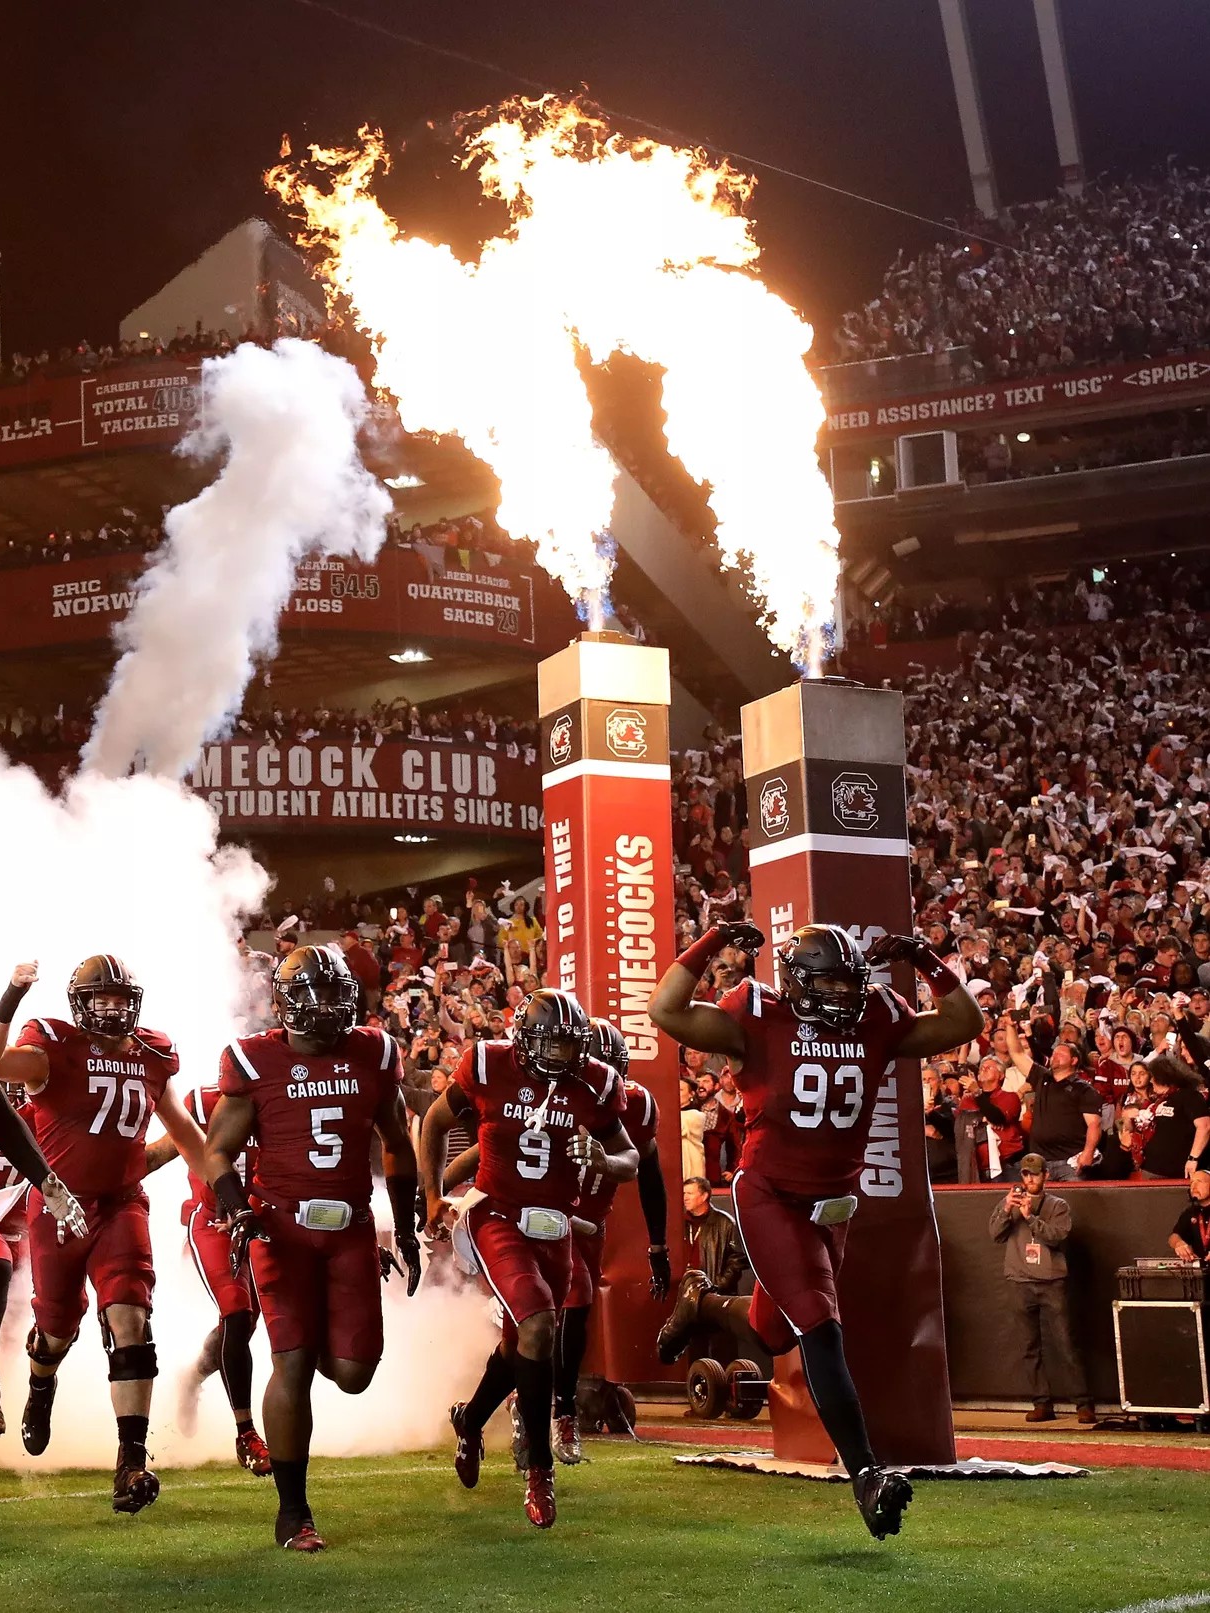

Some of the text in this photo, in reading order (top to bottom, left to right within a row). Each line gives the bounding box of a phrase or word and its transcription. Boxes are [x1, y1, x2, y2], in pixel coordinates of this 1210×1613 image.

[96, 376, 188, 396] CAREER LEADER
[92, 396, 147, 416] TOTAL
[827, 412, 870, 431] NEED
[877, 393, 996, 424] ASSISTANCE?
[1004, 386, 1045, 407] TEXT
[101, 413, 179, 435] TACKLES
[53, 580, 101, 597] ERIC
[331, 573, 379, 599] 54.5
[407, 583, 521, 612] QUARTERBACK
[295, 598, 343, 613] LOSS
[443, 607, 494, 626] SACKS
[402, 750, 496, 797] CLUB
[208, 789, 321, 816] STUDENT
[332, 791, 444, 821] ATHLETES
[454, 797, 513, 828] SINCE
[551, 818, 573, 893] THEE
[605, 855, 616, 954] CAROLINA
[557, 902, 575, 943] TO
[615, 834, 659, 1061] GAMECOCKS
[790, 1041, 866, 1058] CAROLINA
[87, 1058, 146, 1077] CAROLINA
[287, 1079, 360, 1099] CAROLINA
[790, 1063, 864, 1129] 93
[88, 1075, 147, 1138] 70
[503, 1102, 574, 1128] CARLINA
[308, 1106, 344, 1168] 5
[516, 1128, 551, 1180] 9
